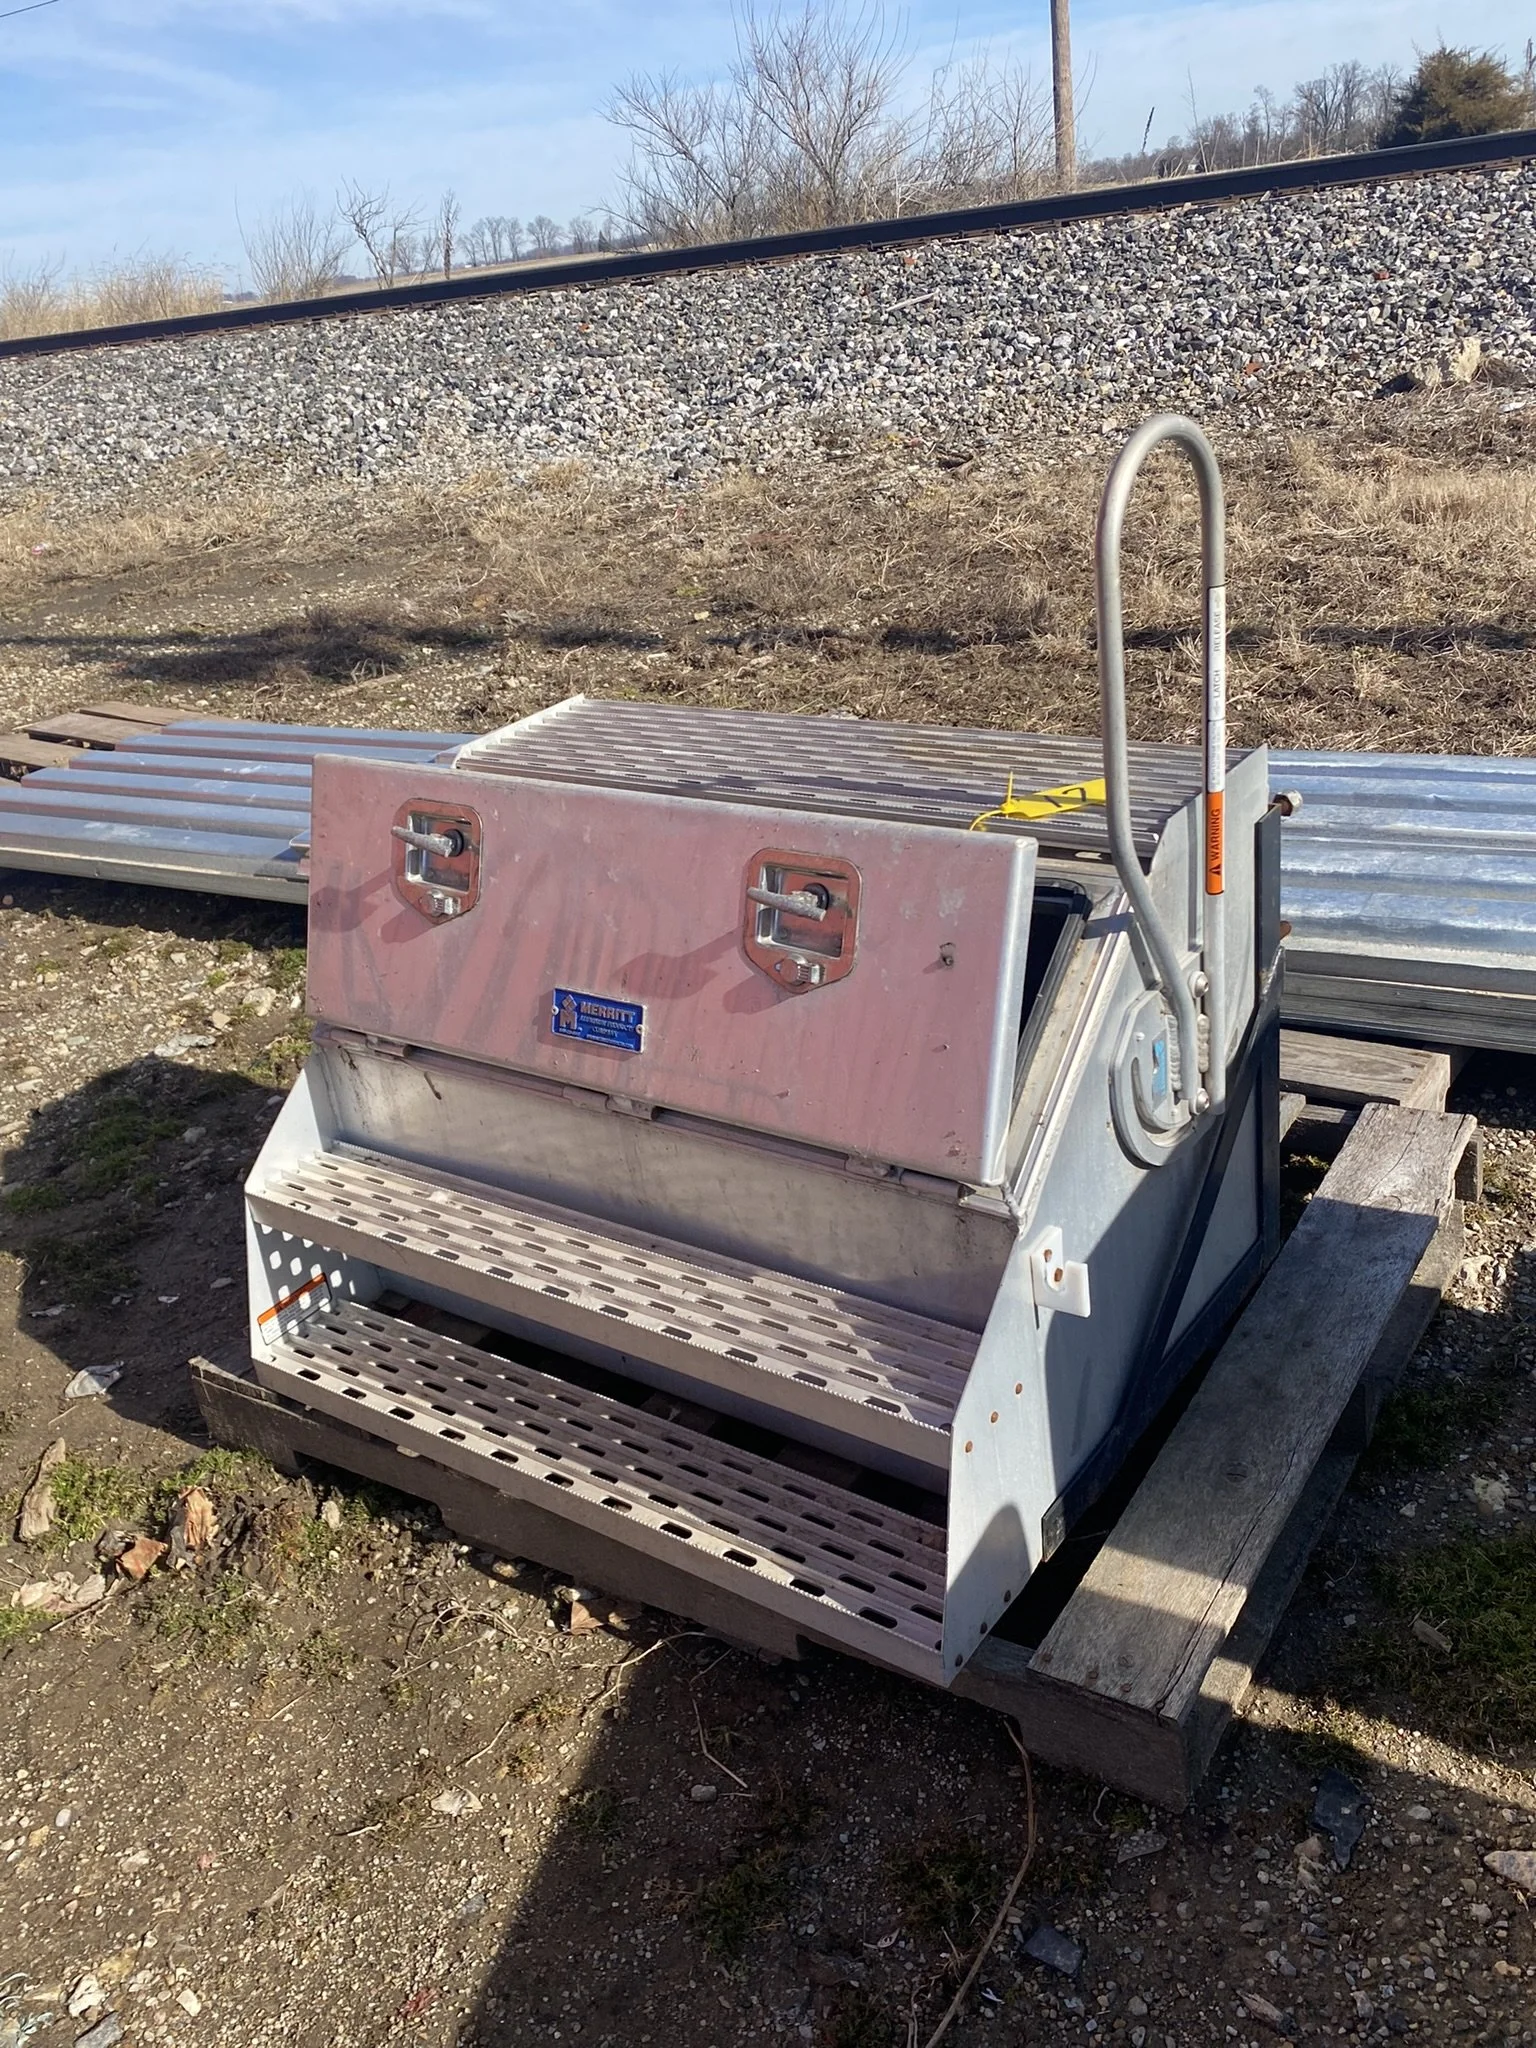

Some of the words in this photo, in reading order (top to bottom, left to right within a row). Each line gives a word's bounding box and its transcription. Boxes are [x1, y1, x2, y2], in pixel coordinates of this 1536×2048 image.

[1213, 612, 1221, 652] RELEASE
[1213, 670, 1221, 699] LATCH
[1210, 808, 1221, 862] WARNING
[580, 1001, 636, 1023] MERRITT
